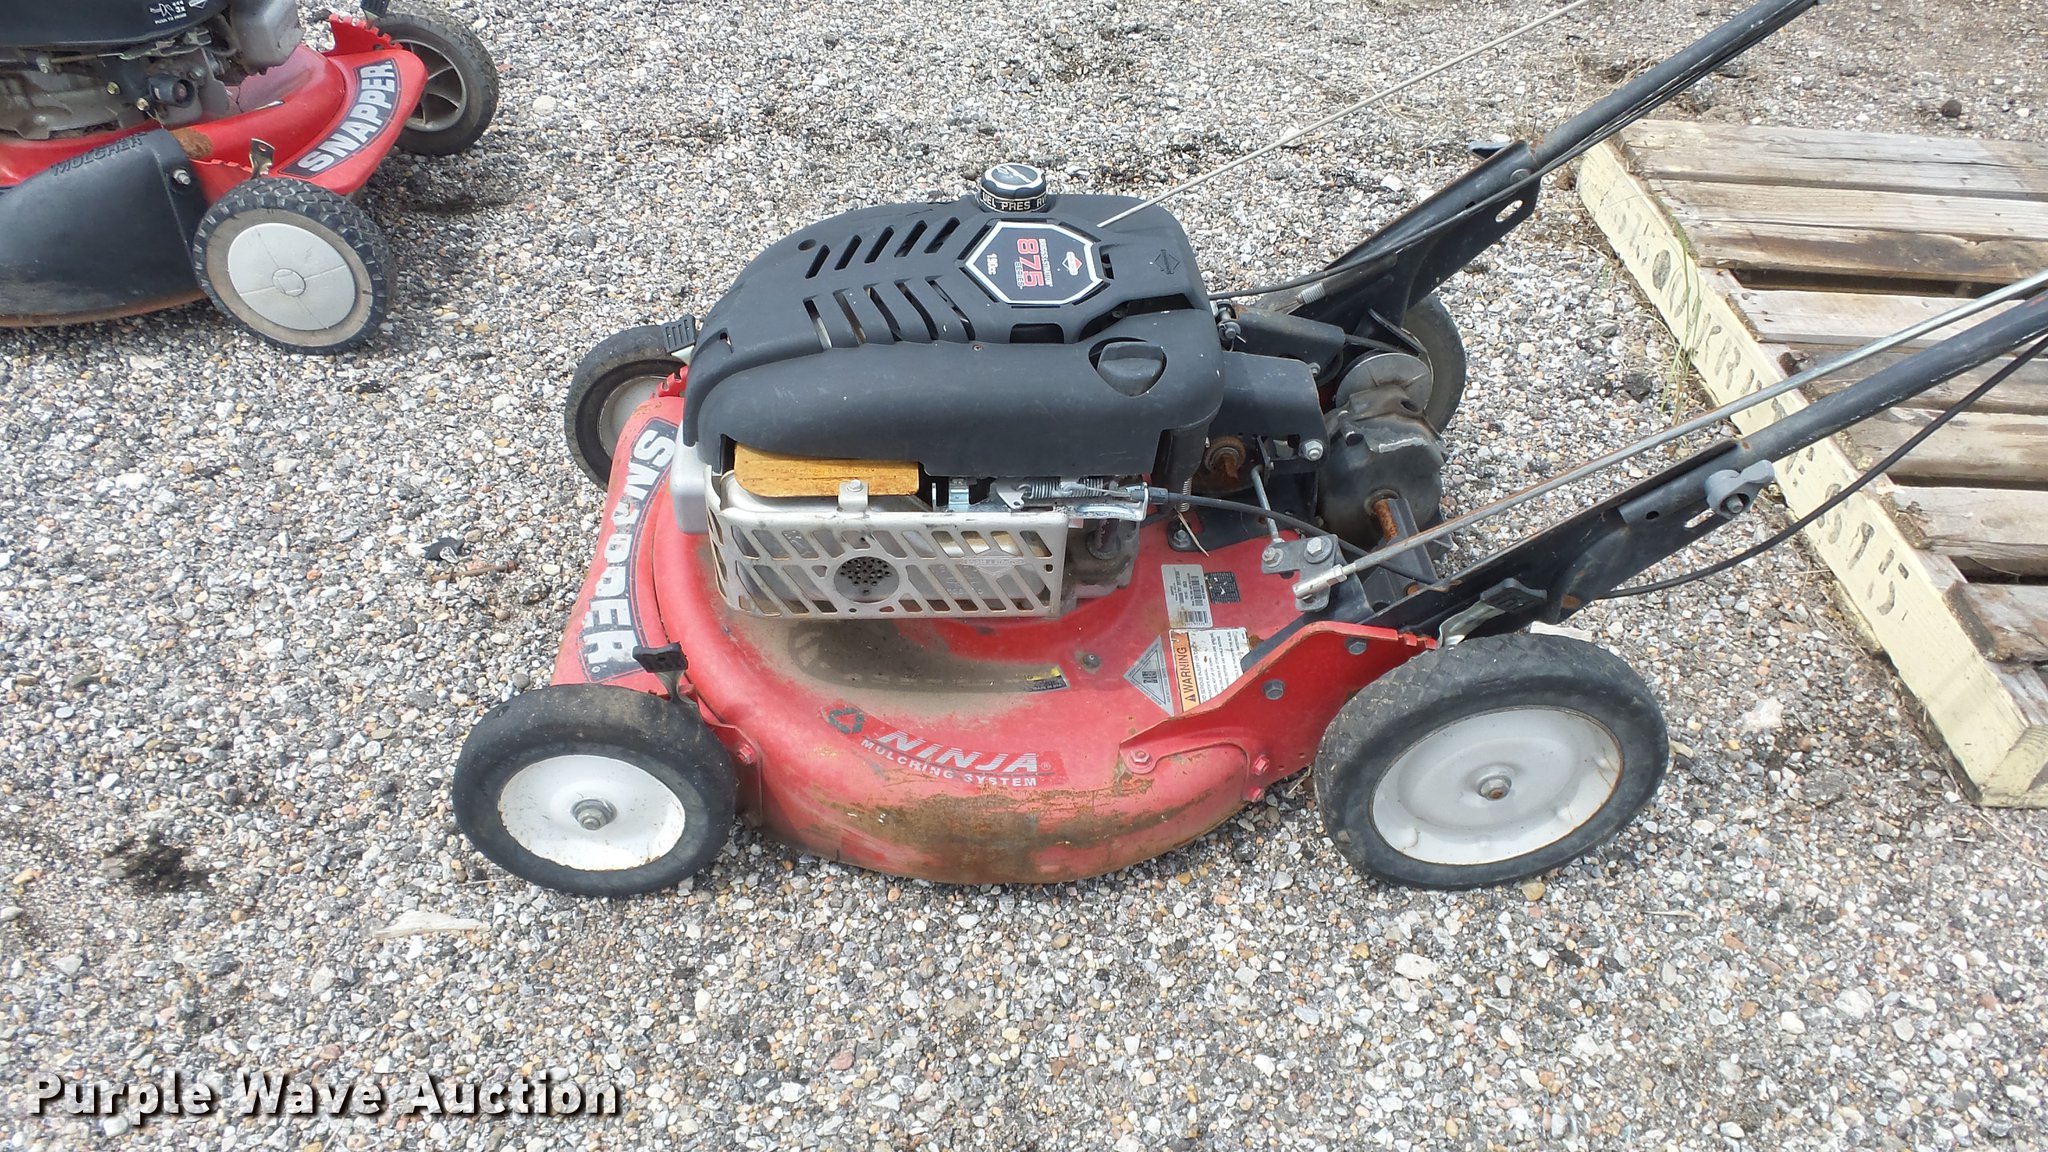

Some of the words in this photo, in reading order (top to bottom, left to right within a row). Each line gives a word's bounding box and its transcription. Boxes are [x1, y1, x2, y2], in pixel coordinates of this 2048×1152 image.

[297, 64, 396, 172] SNAPPER
[50, 135, 143, 176] MULCHER
[982, 191, 997, 208] UEL
[1016, 238, 1044, 288] 875
[583, 428, 677, 665] SNAPPER
[1177, 646, 1196, 693] WARNING
[861, 739, 955, 779] MULCHING
[964, 773, 1038, 787] SYSTEM
[877, 731, 1039, 772] NINJA
